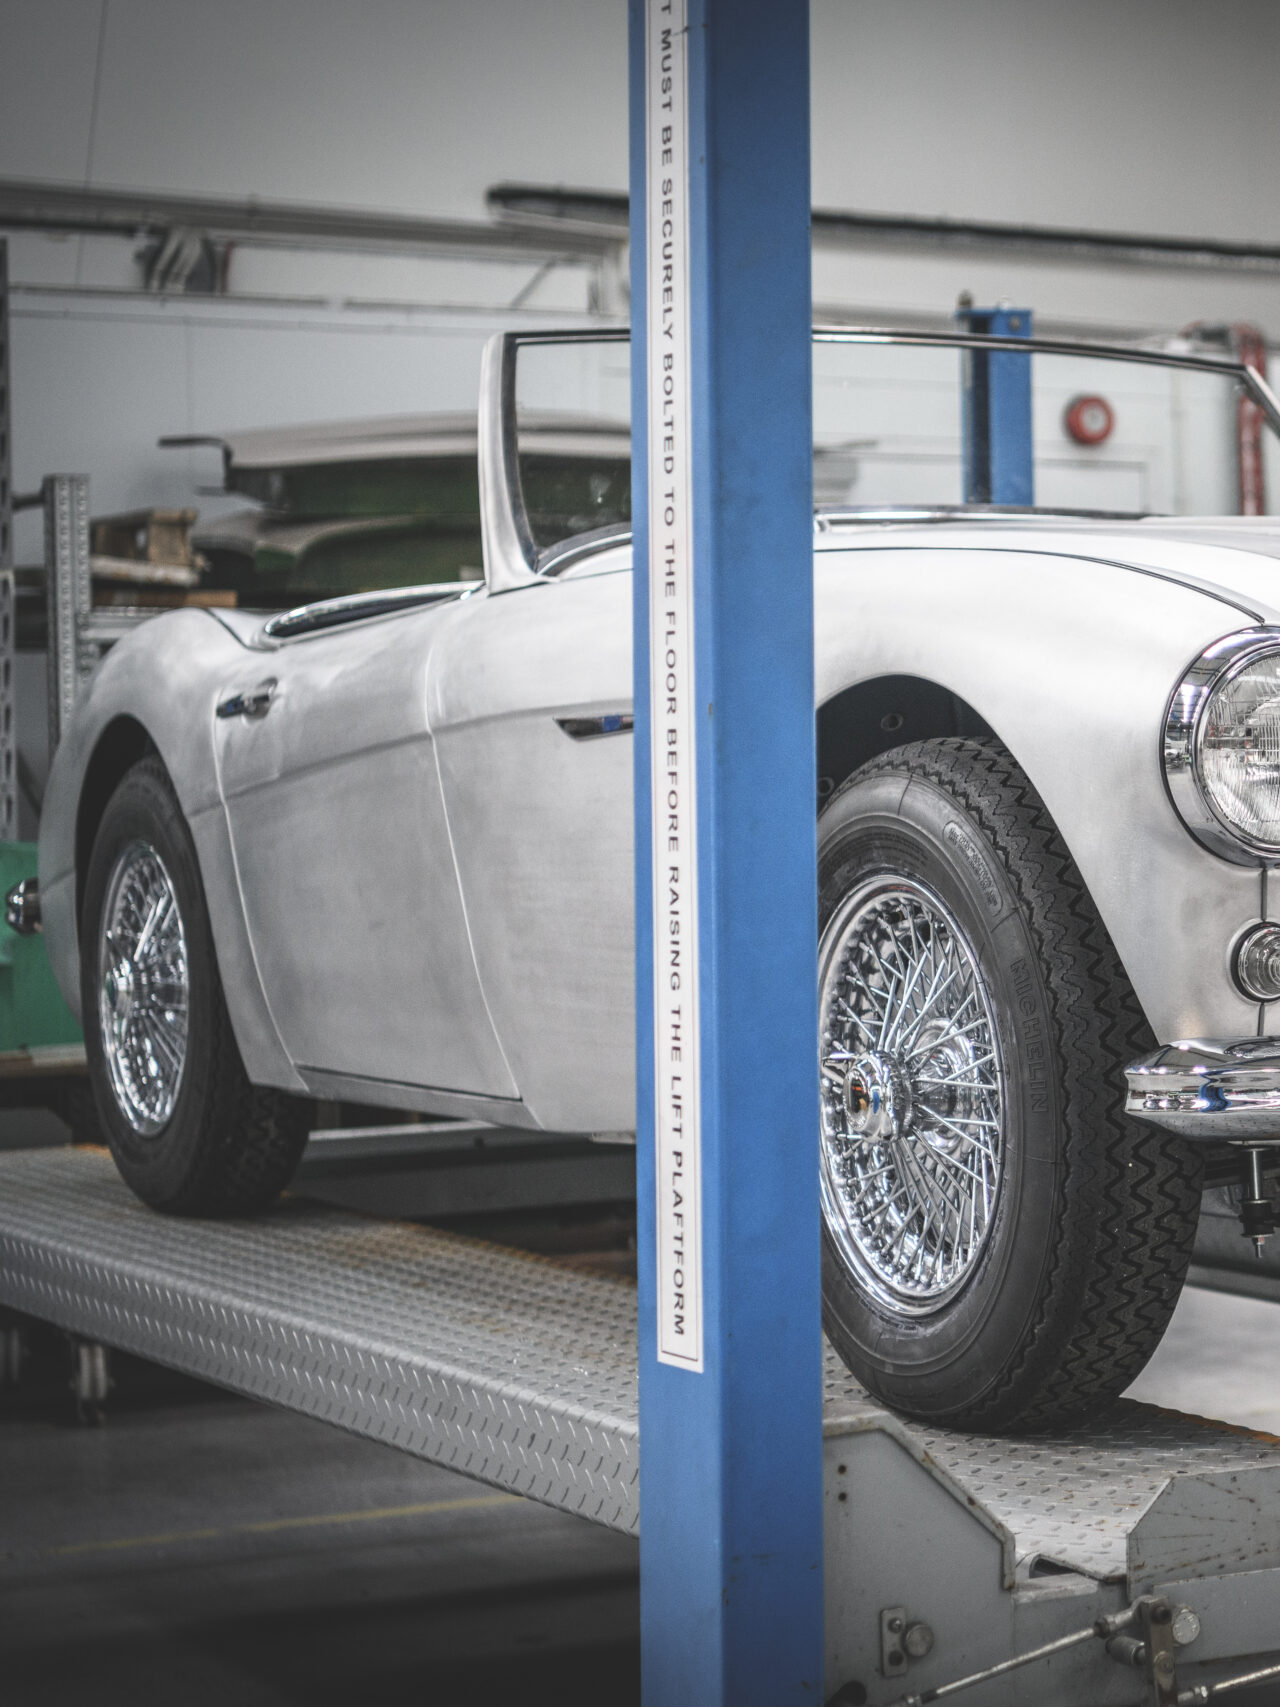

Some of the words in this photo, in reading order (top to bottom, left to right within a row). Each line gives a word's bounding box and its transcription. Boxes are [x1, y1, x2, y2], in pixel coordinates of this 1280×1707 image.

[660, 28, 673, 111] MUST
[661, 125, 673, 165] BE
[661, 178, 673, 340] SECURELY
[663, 353, 675, 475] BOLTED
[664, 489, 675, 527] TO
[664, 540, 676, 596] THE
[665, 611, 677, 714] FLOOR
[667, 729, 679, 851] BEFORE
[668, 866, 681, 991] RAISING
[670, 1006, 682, 1061] THE
[1009, 957, 1049, 1114] MICHELIN
[671, 1075, 683, 1139] LIFT
[672, 1151, 685, 1336] PLAFTFORM
